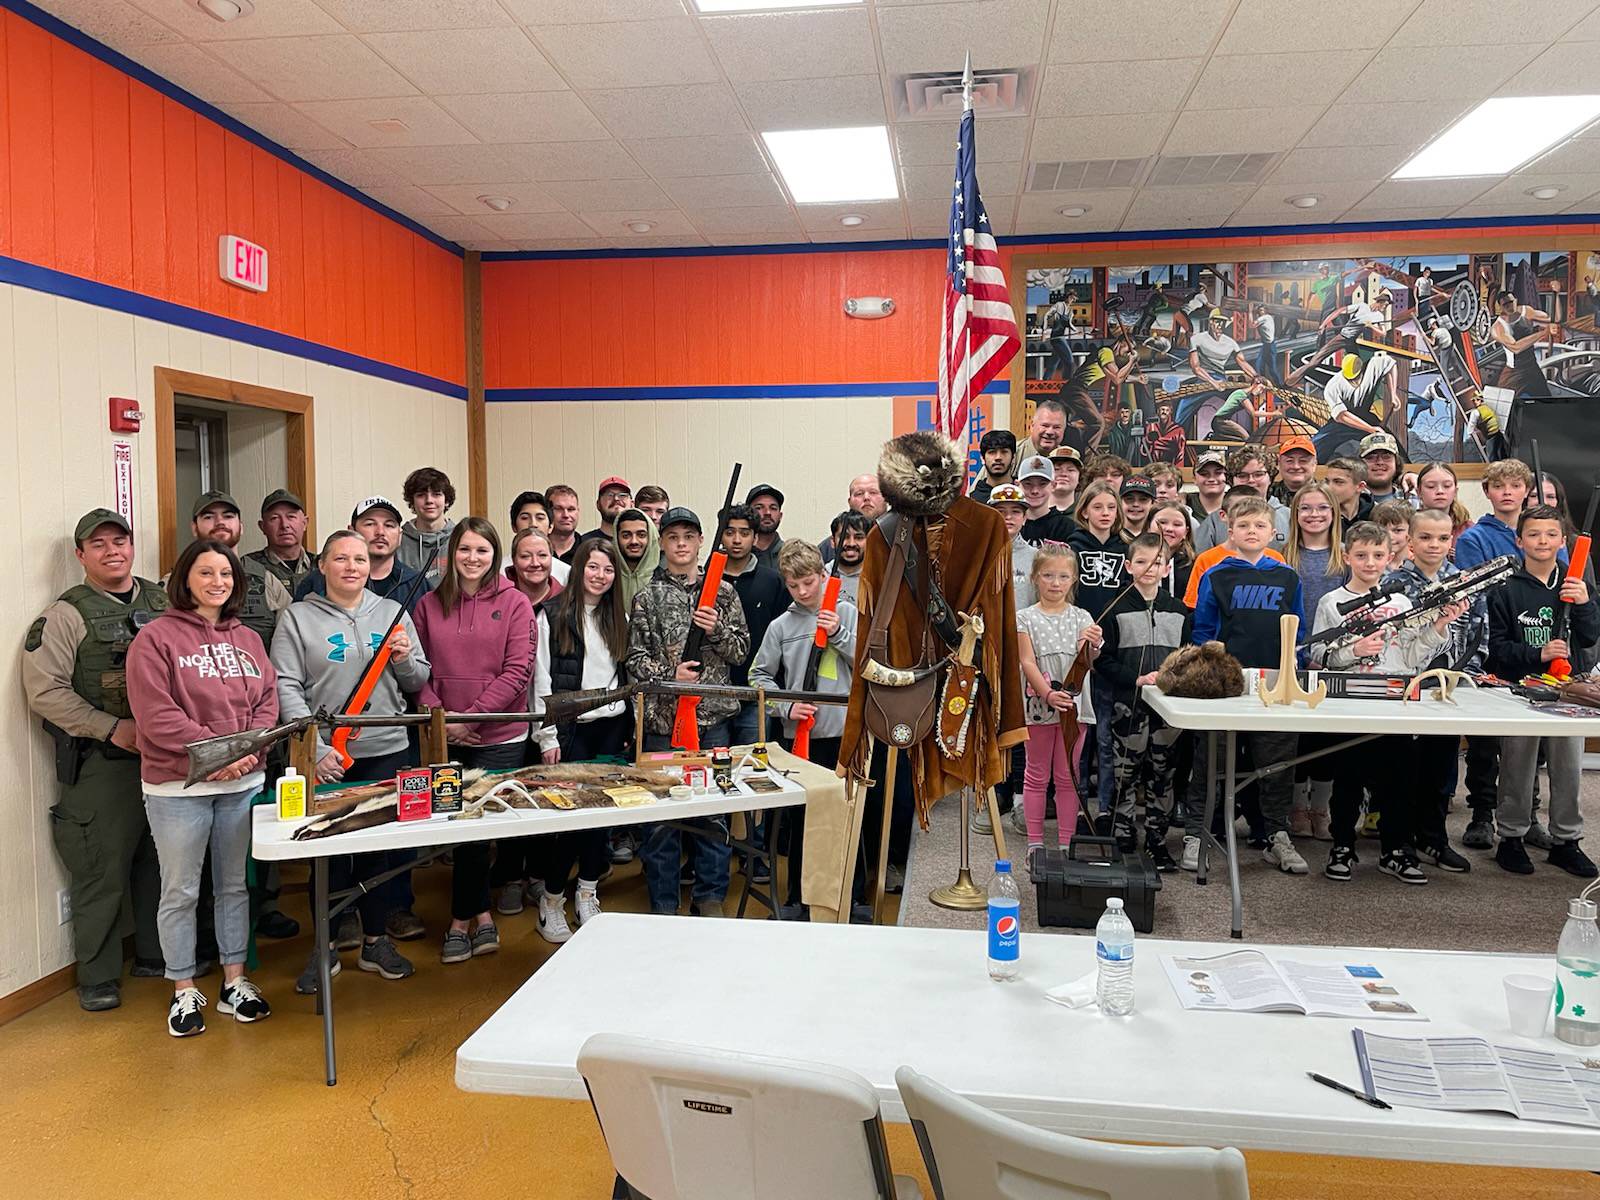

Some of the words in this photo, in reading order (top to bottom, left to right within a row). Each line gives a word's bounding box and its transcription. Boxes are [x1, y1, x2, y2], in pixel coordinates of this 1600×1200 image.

[235, 241, 263, 286] EXIT
[116, 450, 129, 461] FIRE
[1079, 551, 1125, 588] 57
[1231, 584, 1286, 610] NIKE
[1524, 626, 1553, 646] IRI
[200, 642, 234, 657] THE
[178, 653, 237, 670] NORTH
[199, 665, 242, 678] FACE
[687, 1101, 729, 1113] LIFETIME
